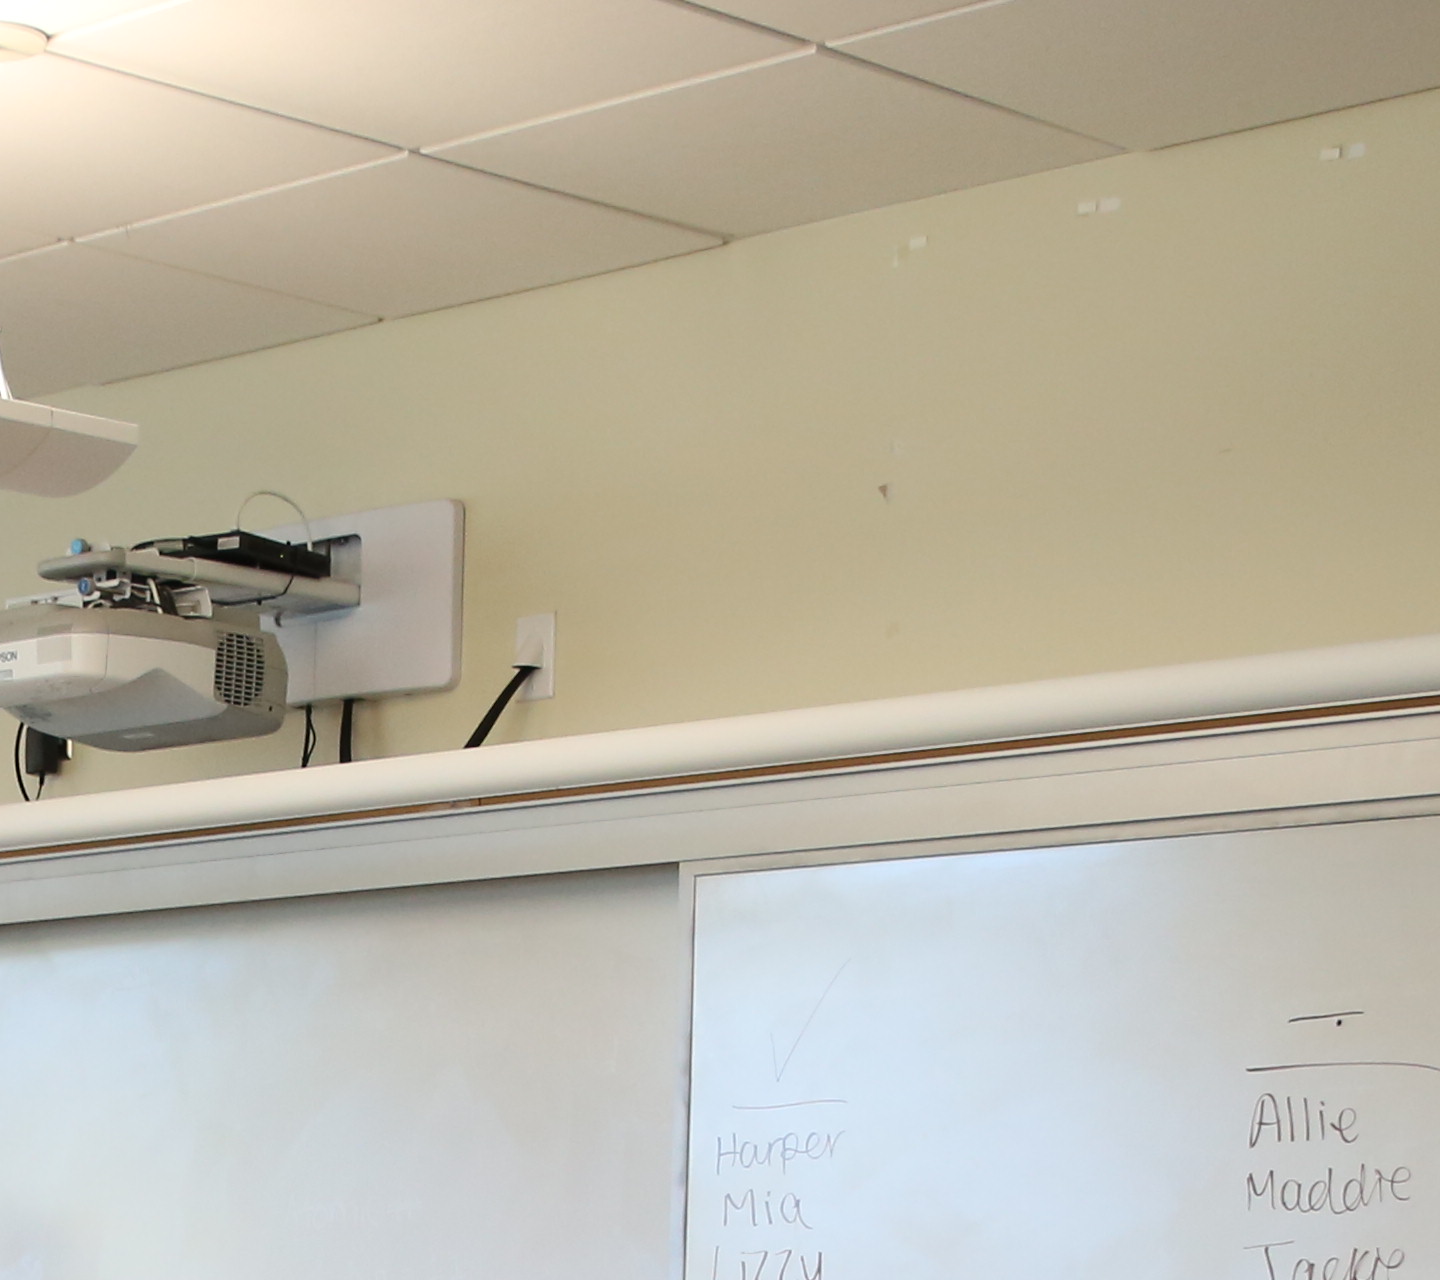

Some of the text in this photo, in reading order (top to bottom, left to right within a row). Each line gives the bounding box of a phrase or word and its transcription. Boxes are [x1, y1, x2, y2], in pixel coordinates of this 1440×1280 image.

[1249, 1093, 1359, 1149] Allie
[716, 1130, 846, 1176] Harper
[723, 1188, 813, 1230] Mia
[1246, 1163, 1411, 1215] Maddie
